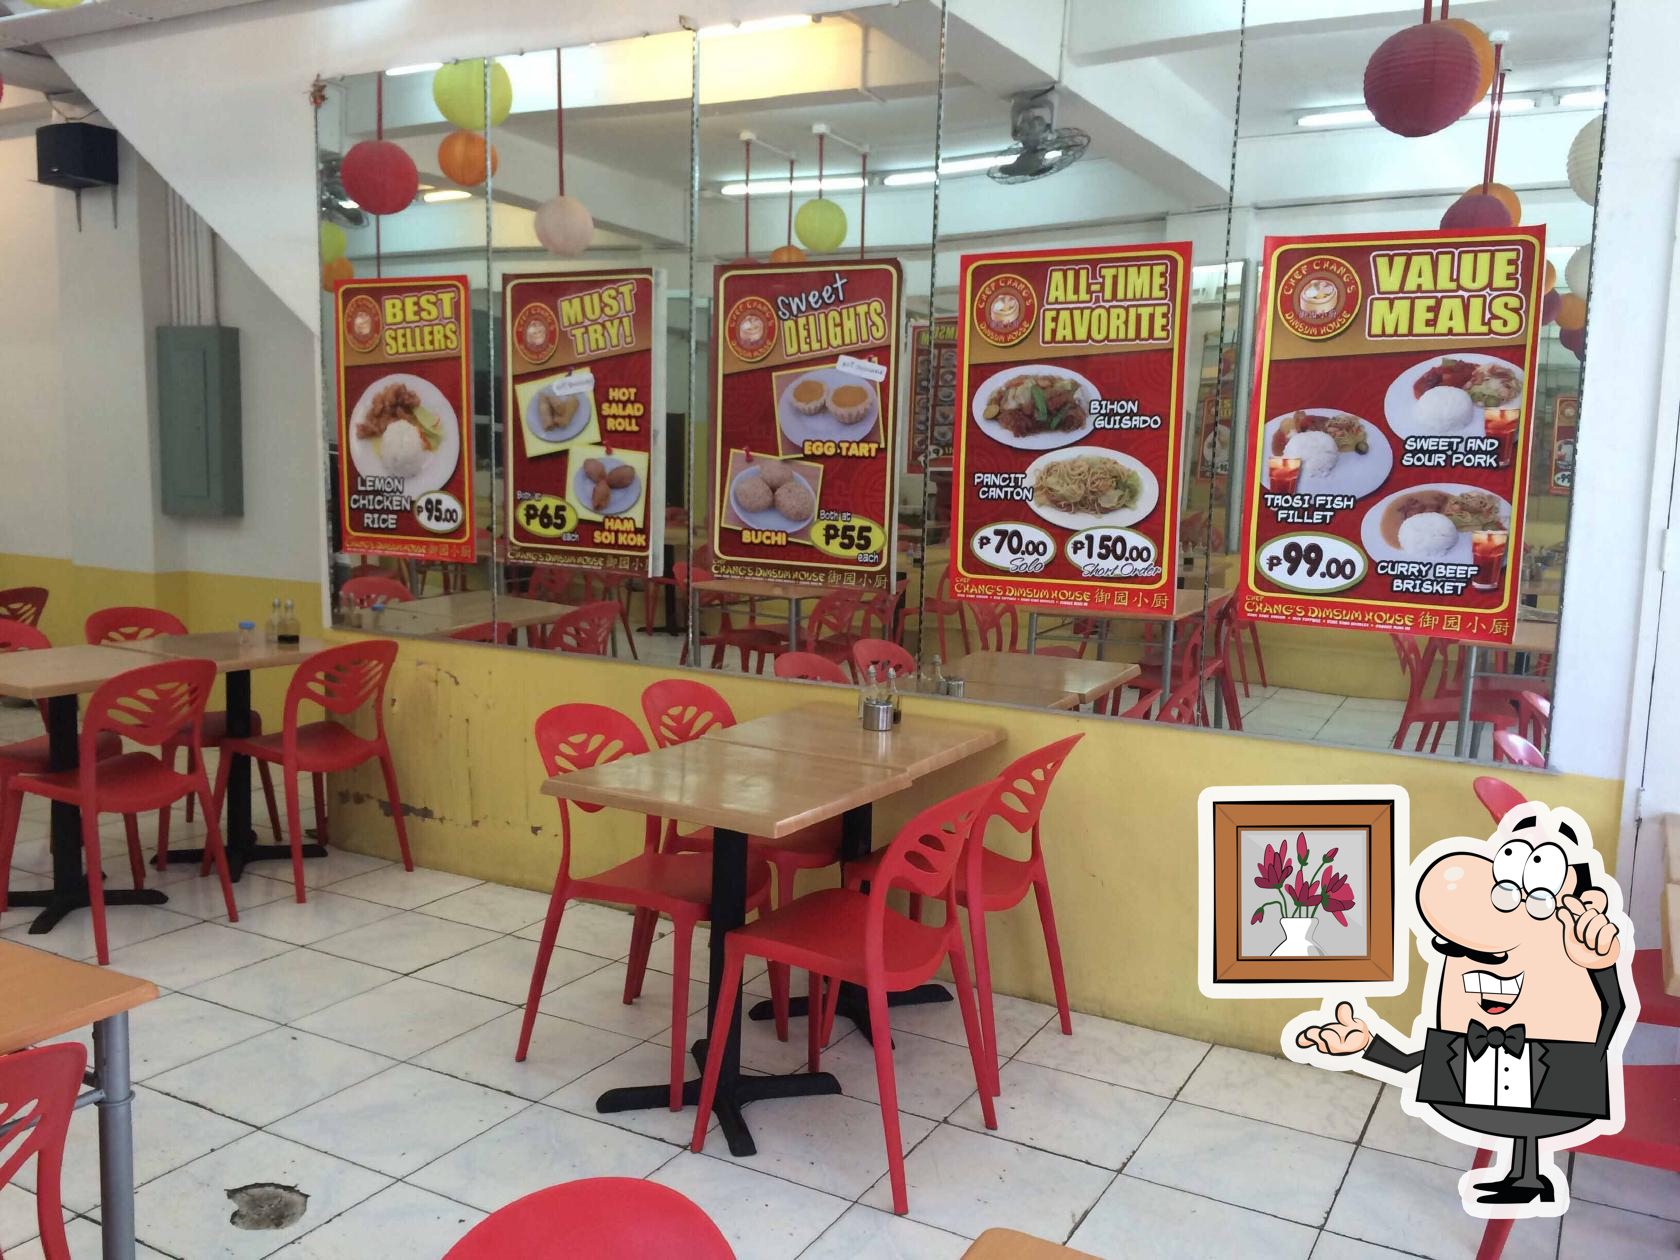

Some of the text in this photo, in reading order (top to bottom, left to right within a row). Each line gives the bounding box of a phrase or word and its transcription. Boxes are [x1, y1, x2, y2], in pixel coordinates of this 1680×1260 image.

[1283, 260, 1356, 295] CHEF CHANG'S
[1375, 251, 1519, 292] VALUE
[1047, 265, 1167, 303] ALL-TIME
[383, 291, 456, 325] BEST
[560, 283, 634, 327] MUST
[1043, 305, 1169, 342] FAVORITE
[1284, 311, 1351, 335] DIMSUM HOUSE
[1369, 295, 1521, 336] MEALS
[571, 316, 633, 354] TRY!
[783, 300, 886, 356] DELIGHTS
[384, 322, 458, 355] SELLERS
[608, 387, 637, 401] HOT
[601, 403, 644, 416] SALAD
[1090, 400, 1138, 414] BIHON
[606, 418, 640, 431] ROLL
[1094, 415, 1161, 429] GUISADO
[804, 440, 879, 457] EGG TART
[1404, 437, 1499, 451] SWEET AND
[1401, 453, 1498, 467] SOUR PORK
[357, 476, 404, 492] LEMON
[974, 473, 1026, 486] PANCIT
[979, 487, 1033, 500] CANTON
[1264, 494, 1354, 509] TAOSI FISH
[350, 494, 411, 511] CHICKEN
[363, 513, 398, 529] RICE
[820, 510, 838, 520] Both
[1277, 510, 1334, 524] FILLET
[604, 517, 635, 531] HAM
[593, 531, 647, 546] SOI KOK
[741, 530, 787, 546] BUCHI
[857, 552, 879, 563] each
[1009, 557, 1045, 573] Solo
[712, 564, 753, 576] CHANG'S
[1082, 562, 1161, 577] Short Order
[1377, 562, 1479, 578] CURRY BEEF
[954, 583, 1003, 596] CHANG'S
[1005, 586, 1049, 599] DIMSUM
[1051, 589, 1091, 602] HOUSE
[1392, 579, 1466, 595] BRISKET
[1244, 601, 1305, 617] CHANG'S
[1307, 606, 1362, 621] DIMSUM
[1365, 611, 1415, 626] HOUSE
